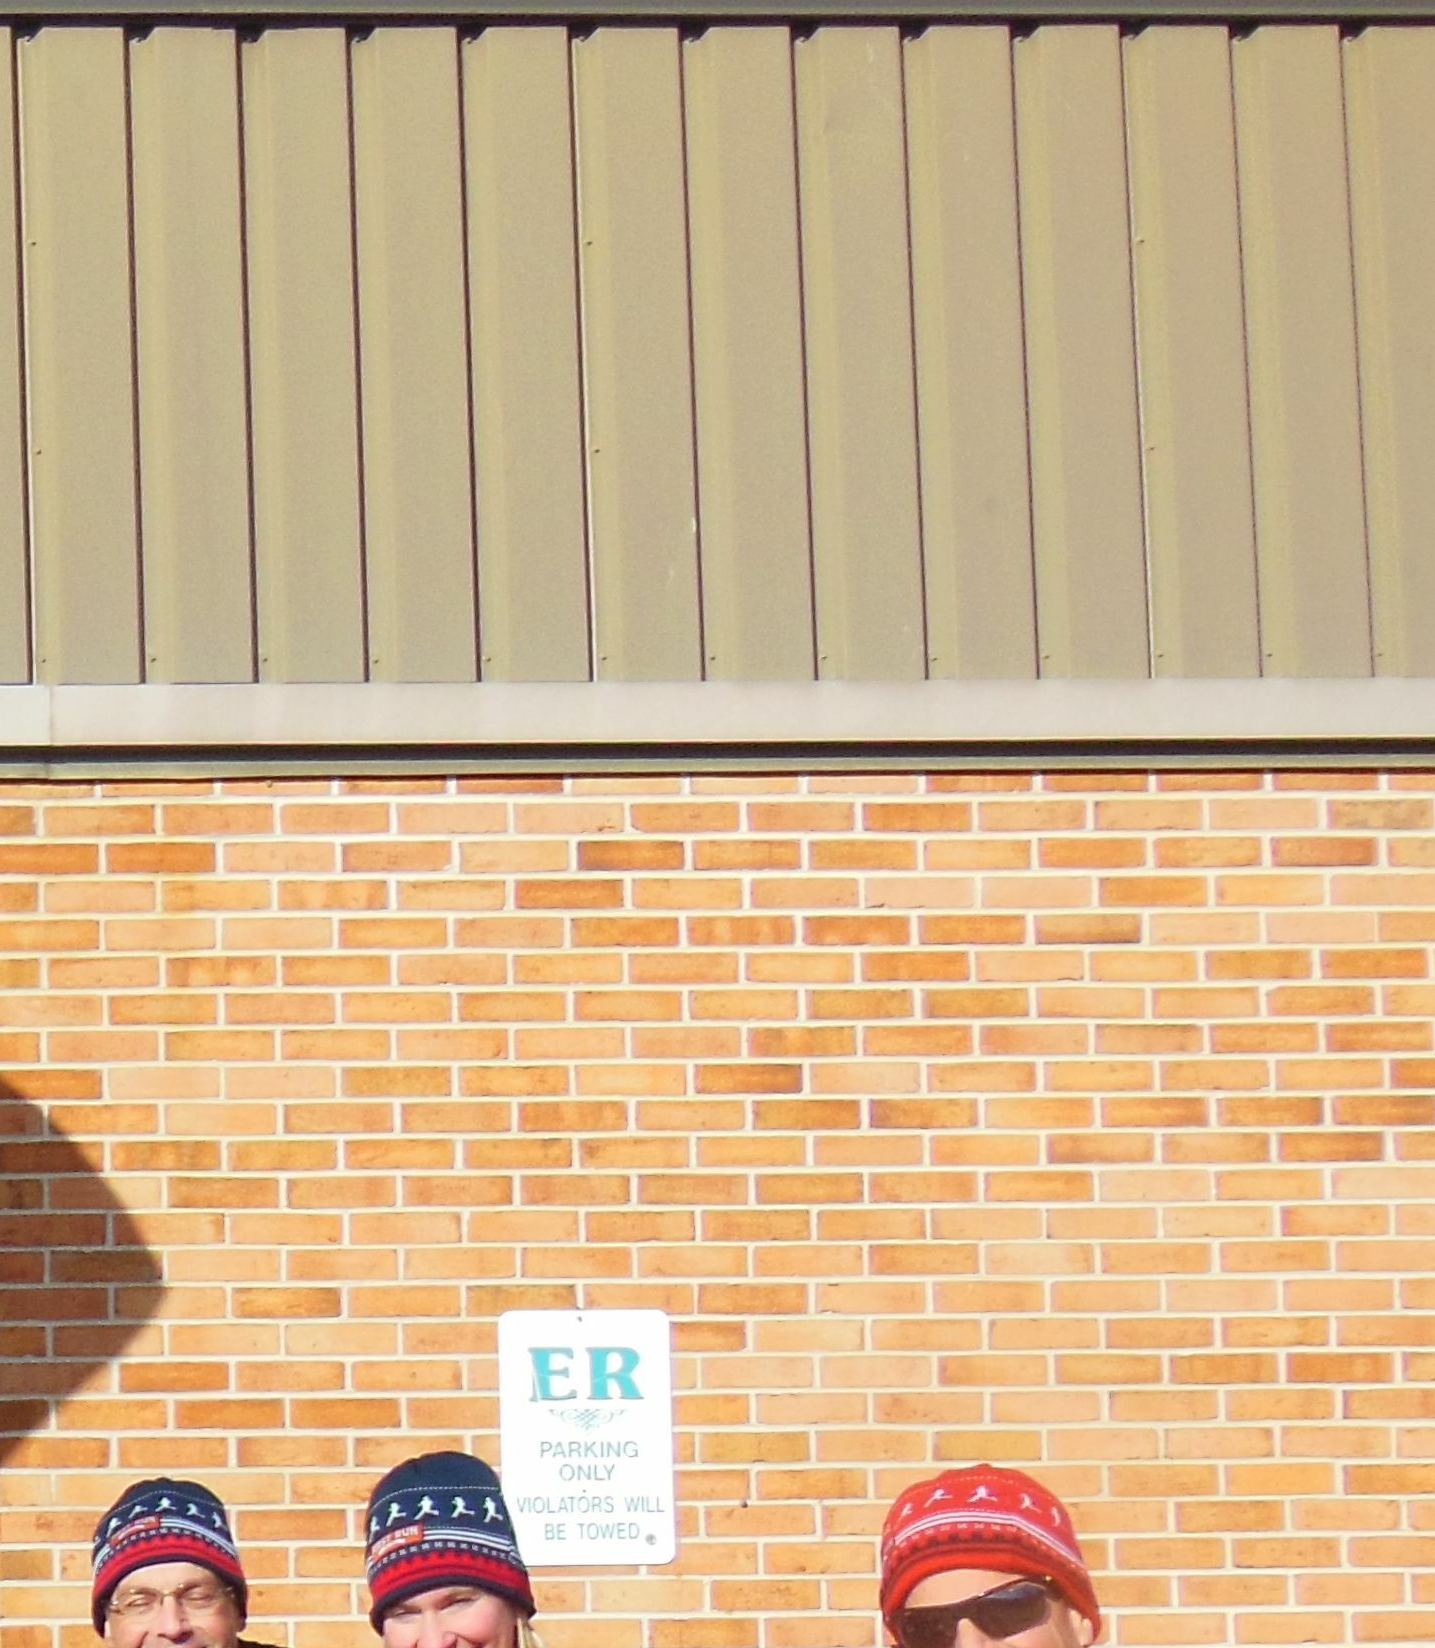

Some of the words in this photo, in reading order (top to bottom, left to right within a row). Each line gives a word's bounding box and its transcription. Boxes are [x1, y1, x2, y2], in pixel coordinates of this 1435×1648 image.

[527, 1346, 645, 1403] ER
[540, 1440, 639, 1459] PARKING
[558, 1463, 616, 1482] ONLY
[516, 1496, 615, 1514] VIOLATORS
[625, 1495, 665, 1513] WILL
[544, 1523, 567, 1540] BE
[579, 1523, 640, 1540] TOWED
